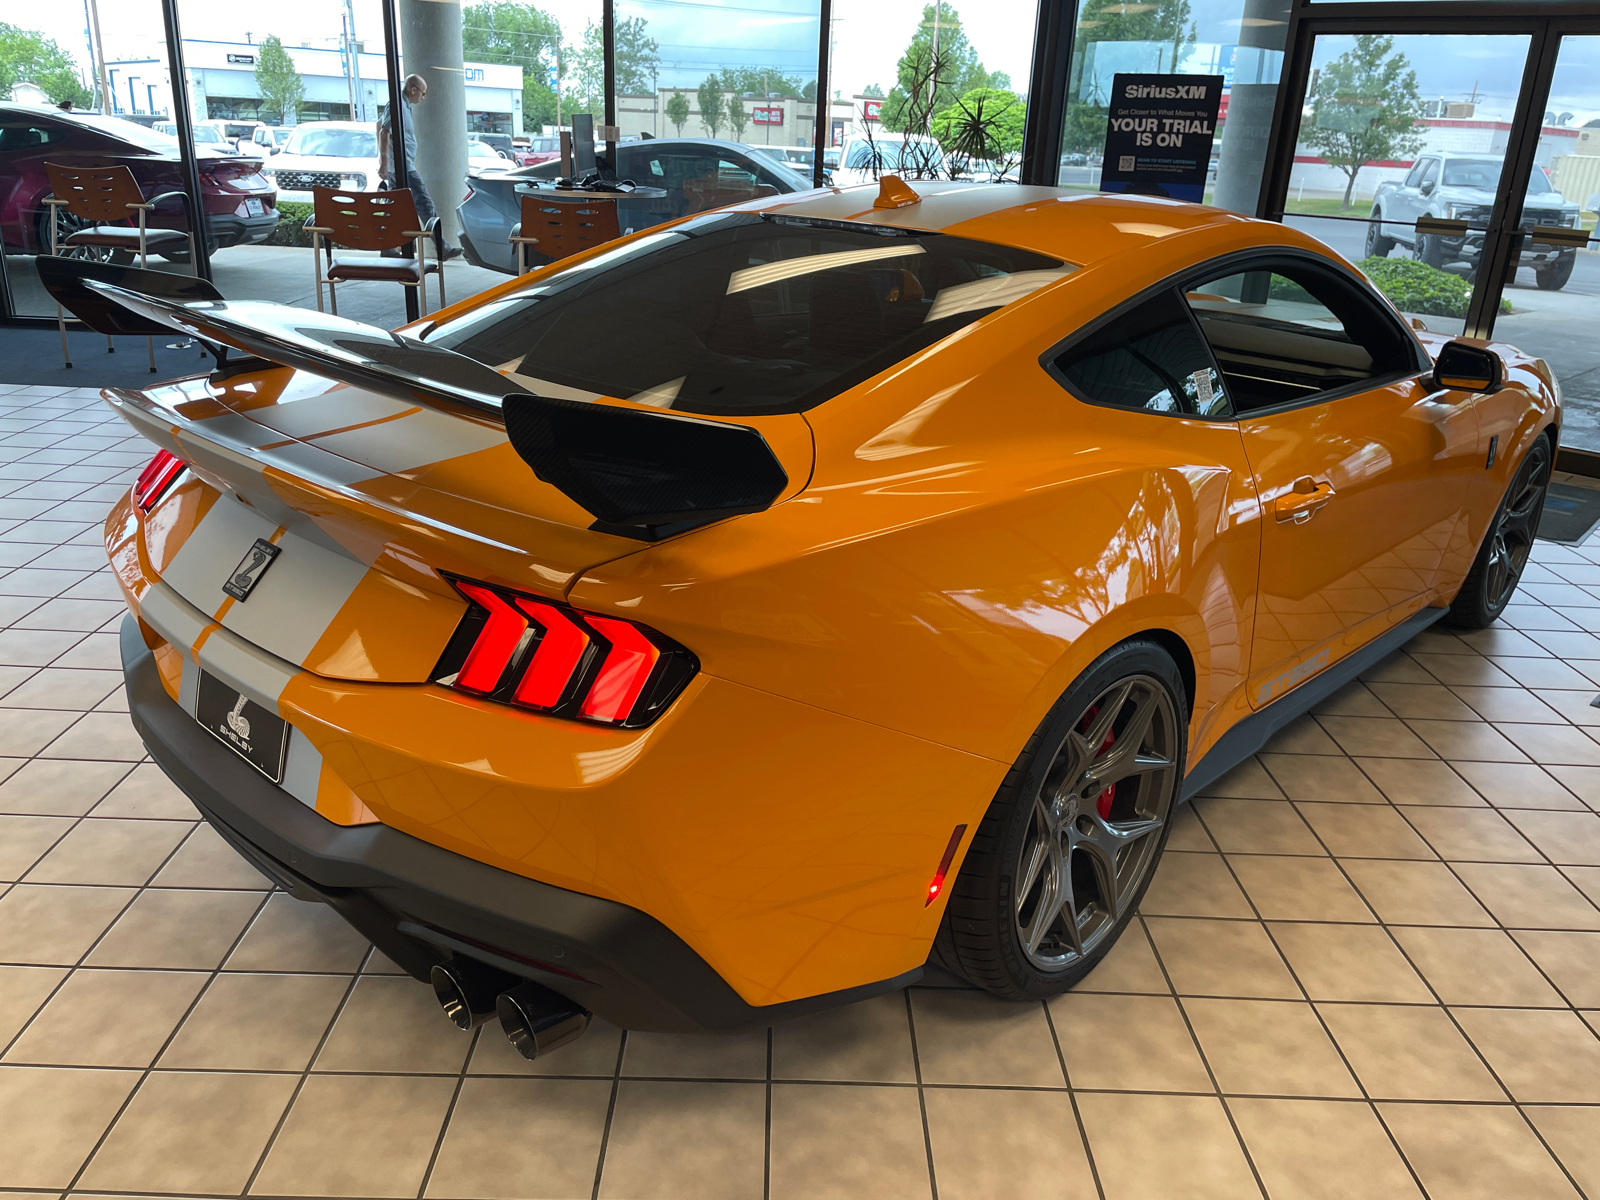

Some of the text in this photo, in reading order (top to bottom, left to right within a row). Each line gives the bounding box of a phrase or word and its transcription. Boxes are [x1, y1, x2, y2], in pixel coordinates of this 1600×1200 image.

[465, 68, 484, 81] om
[1125, 85, 1207, 99] SiriusXM
[1118, 108, 1129, 116] Get
[1130, 108, 1149, 116] Closer
[1175, 109, 1195, 117] Moves
[1196, 110, 1208, 118] You
[1111, 118, 1213, 134] YOUR TRIAL
[1136, 132, 1183, 148] IS ON
[220, 724, 253, 754] SHELBY
